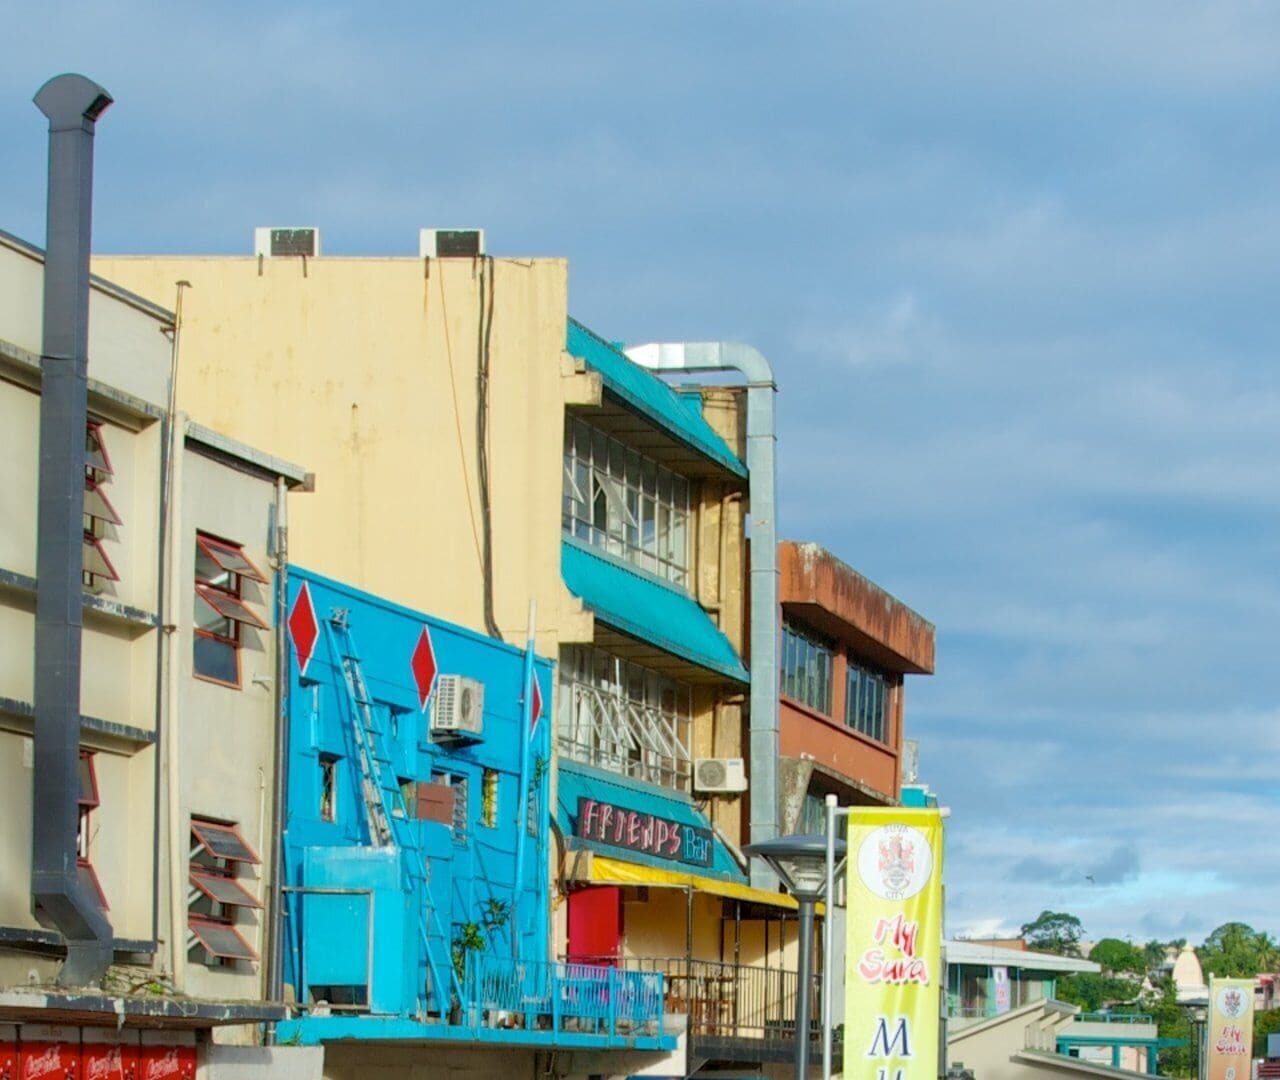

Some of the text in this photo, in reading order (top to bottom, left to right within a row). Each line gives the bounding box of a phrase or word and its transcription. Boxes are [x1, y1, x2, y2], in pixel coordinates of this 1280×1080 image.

[683, 826, 712, 862] Bar
[874, 914, 917, 957] My
[859, 949, 929, 984] Suva
